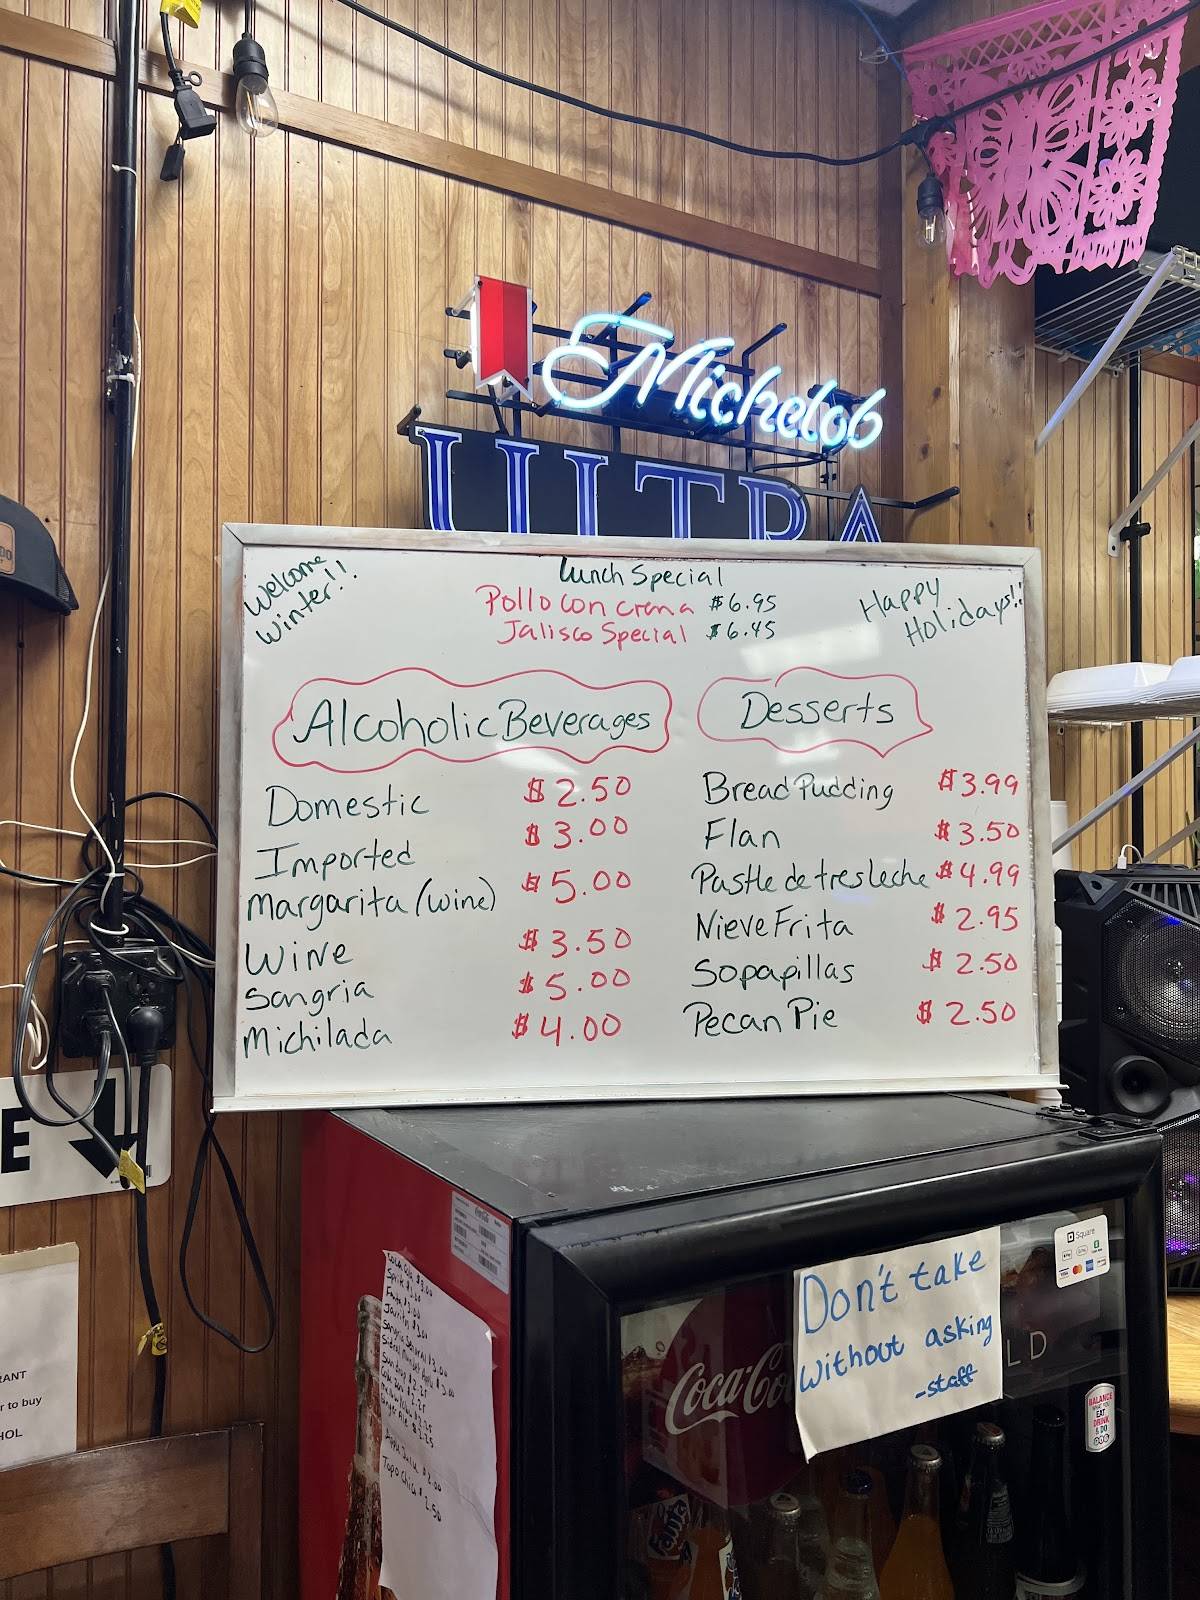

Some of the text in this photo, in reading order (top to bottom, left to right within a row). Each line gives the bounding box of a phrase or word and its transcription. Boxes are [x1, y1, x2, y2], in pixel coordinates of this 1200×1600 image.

[542, 312, 887, 450] Michelob
[244, 556, 327, 616] Welcome
[631, 564, 723, 592] Special
[475, 585, 551, 616] Pollo
[709, 593, 777, 614] $6.95
[497, 620, 776, 651] Jalisco Special $6.45
[293, 698, 651, 747] Alcoholic Beverages
[740, 691, 894, 731] Desserts
[702, 772, 895, 812] Bread Pudding
[938, 769, 1019, 797] $3.99
[266, 785, 430, 827] Domestic
[705, 817, 781, 850] Flan
[934, 819, 1020, 846] $3.50
[255, 840, 416, 881] Imported
[785, 862, 812, 892] de
[936, 859, 1020, 888] $4.99
[247, 877, 497, 931] Margarita (wine)
[696, 904, 854, 942] Nieve Frita
[691, 954, 855, 991] Sopapillas
[683, 997, 839, 1038] Pecan Pie
[243, 1017, 393, 1059] Michilada
[1075, 1228, 1096, 1240] Square
[803, 1250, 986, 1335] Don't take
[924, 1312, 995, 1350] asking
[0, 1370, 28, 1384] ANT
[665, 1343, 794, 1435] Coca-Co
[8, 1401, 19, 1410] to
[22, 1396, 43, 1408] buy
[1088, 1392, 1114, 1407] BALANCE
